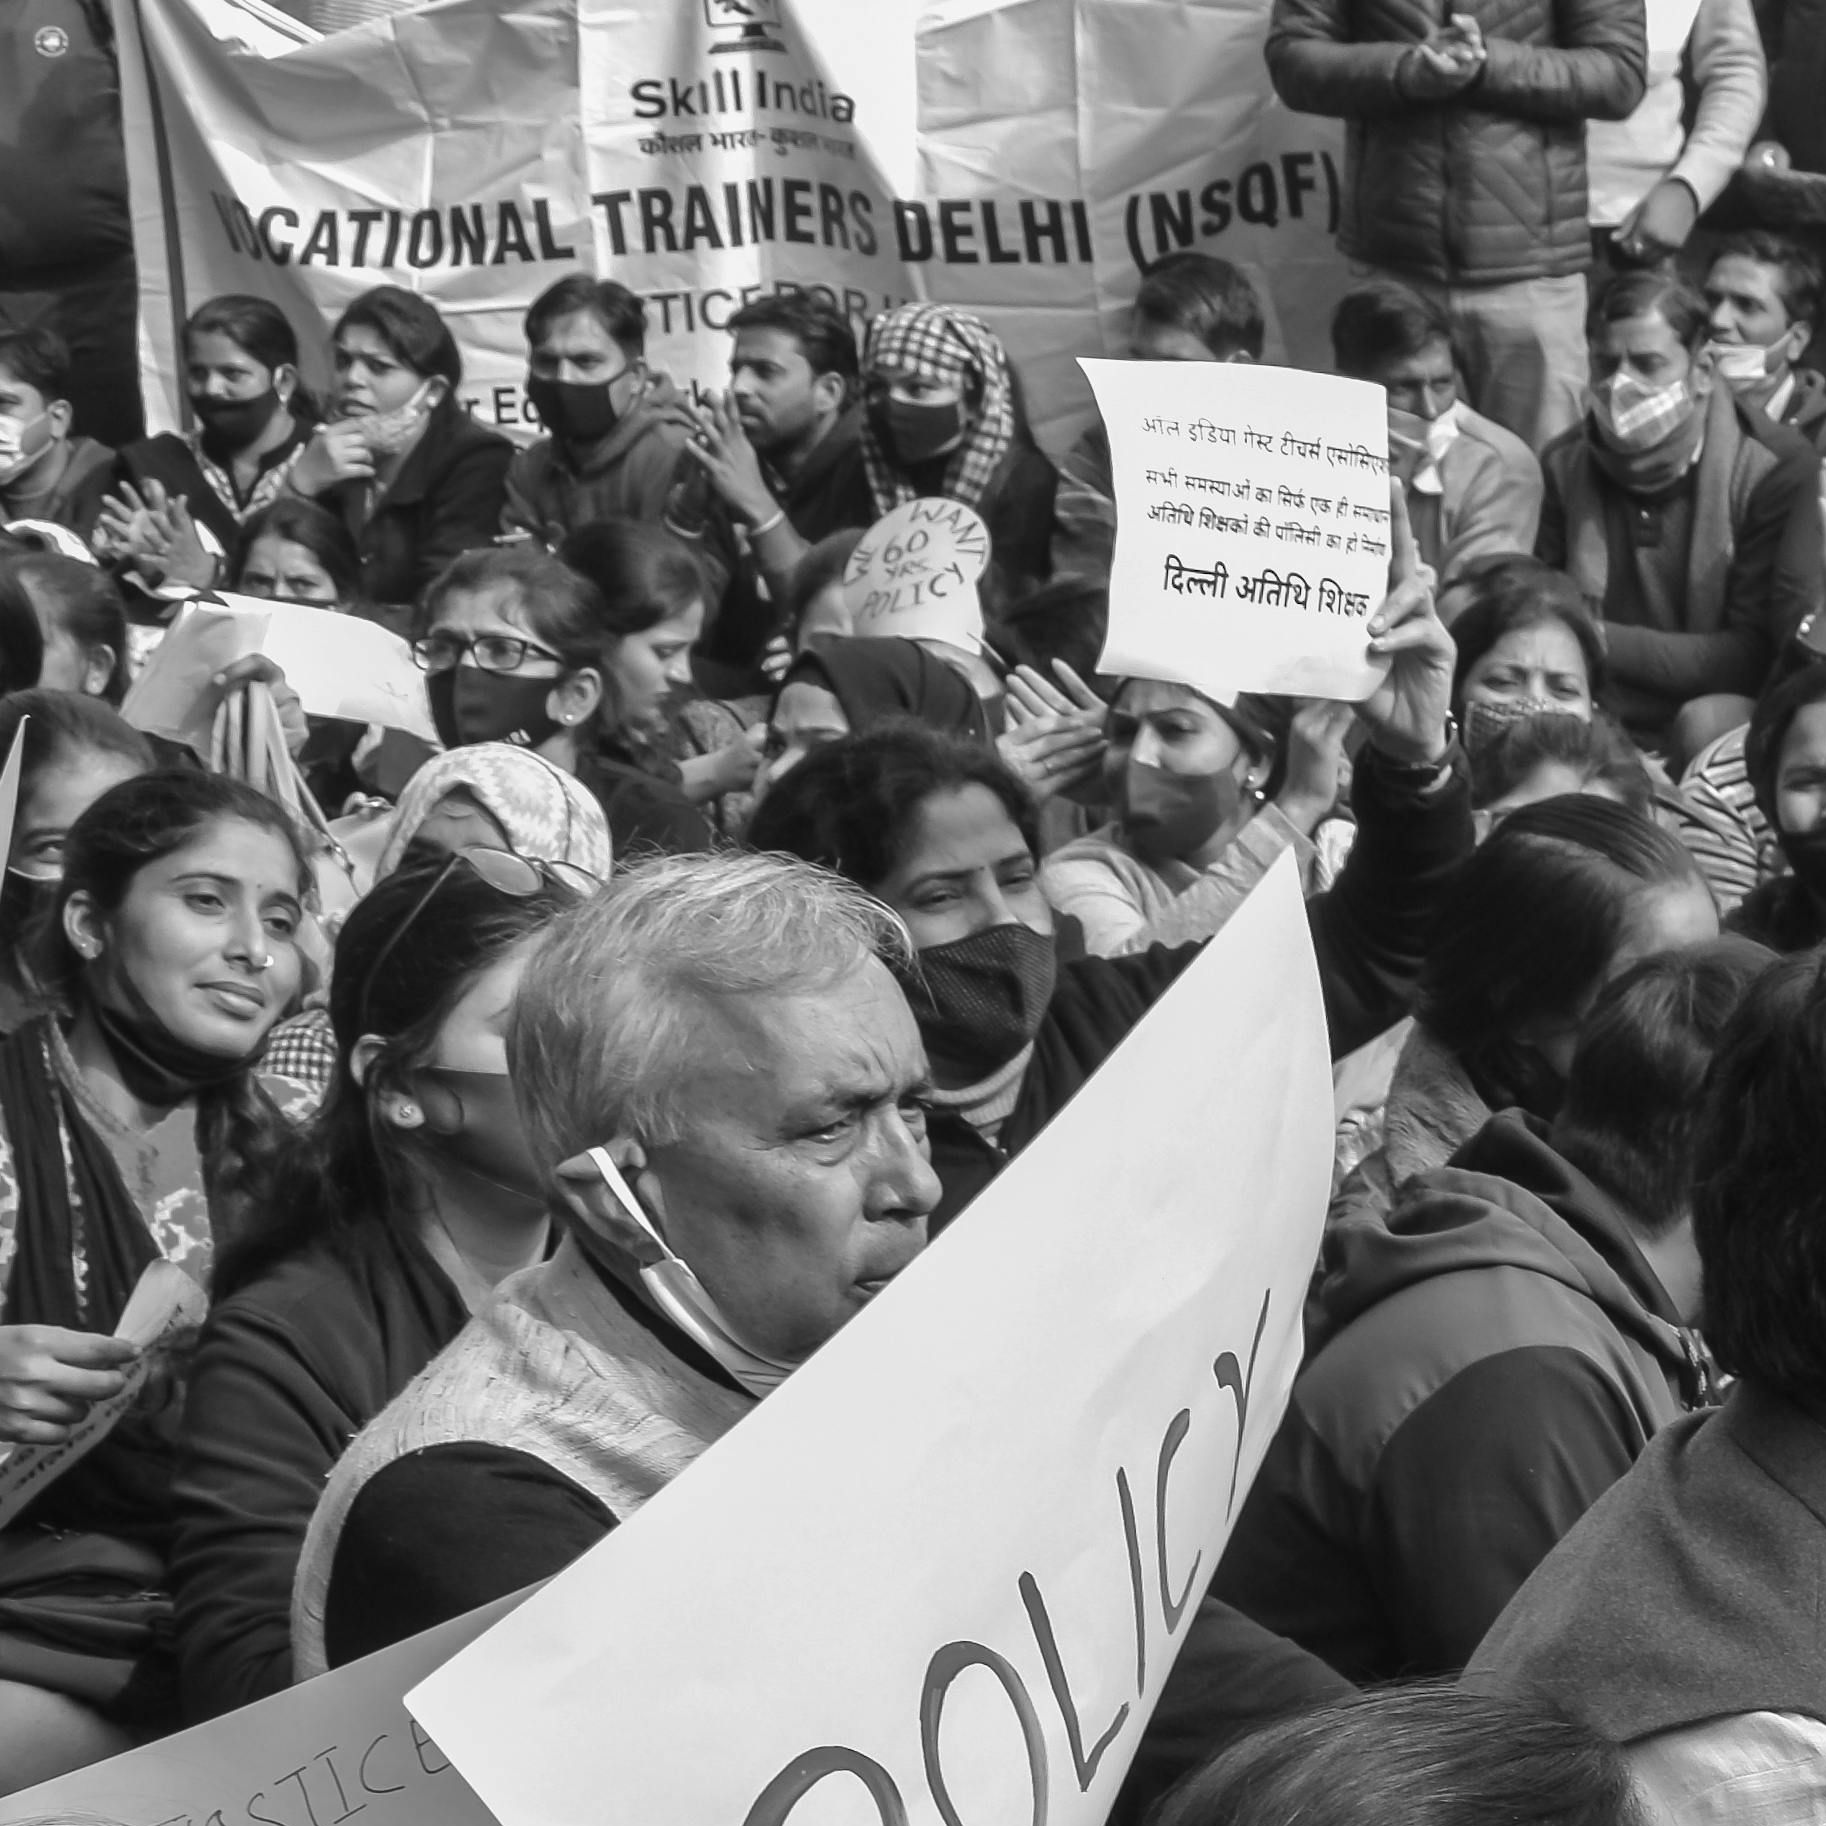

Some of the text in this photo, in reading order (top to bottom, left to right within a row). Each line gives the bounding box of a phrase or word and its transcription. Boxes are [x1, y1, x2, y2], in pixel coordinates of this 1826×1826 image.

[630, 68, 856, 123] Skill India
[592, 177, 879, 257] TRAINERS
[892, 198, 1094, 264] DELHI
[1125, 150, 1340, 277] (NSQF)
[1255, 486, 1272, 504] का
[883, 529, 929, 563] 60
[908, 501, 987, 565] WANT
[1253, 516, 1270, 538] की
[1326, 533, 1341, 550] का
[858, 561, 965, 620] POLICY
[1163, 553, 1370, 618] दिल्ली अतिथि शिक्षक
